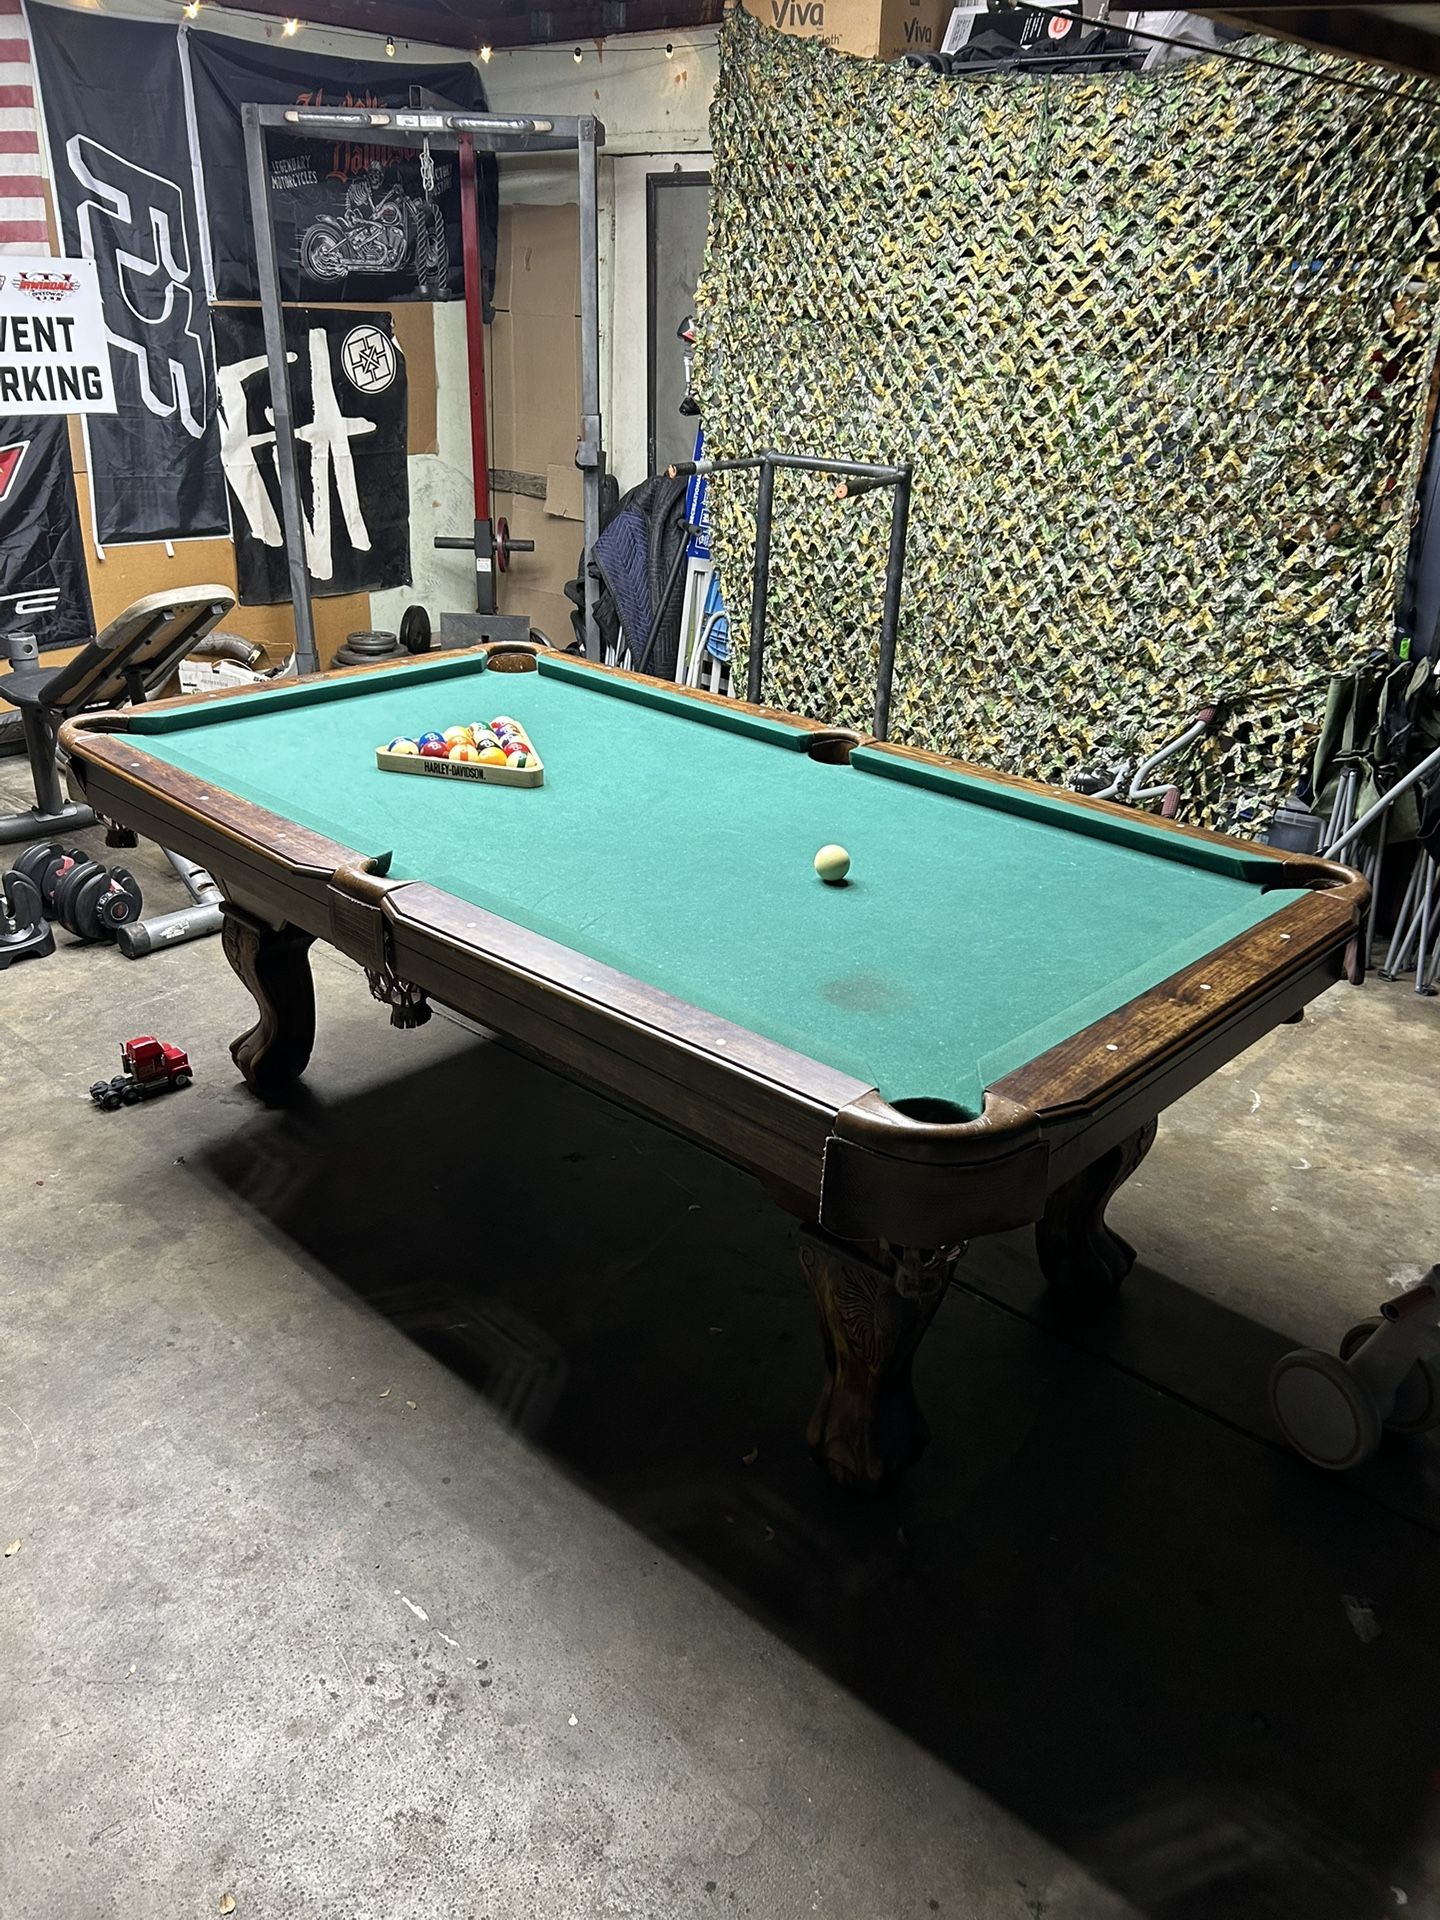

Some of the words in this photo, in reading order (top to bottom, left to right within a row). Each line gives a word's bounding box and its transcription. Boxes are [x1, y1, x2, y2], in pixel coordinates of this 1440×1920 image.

[772, 0, 824, 27] Viva
[904, 17, 932, 43] Viva
[271, 170, 319, 190] MOTORCYCLES
